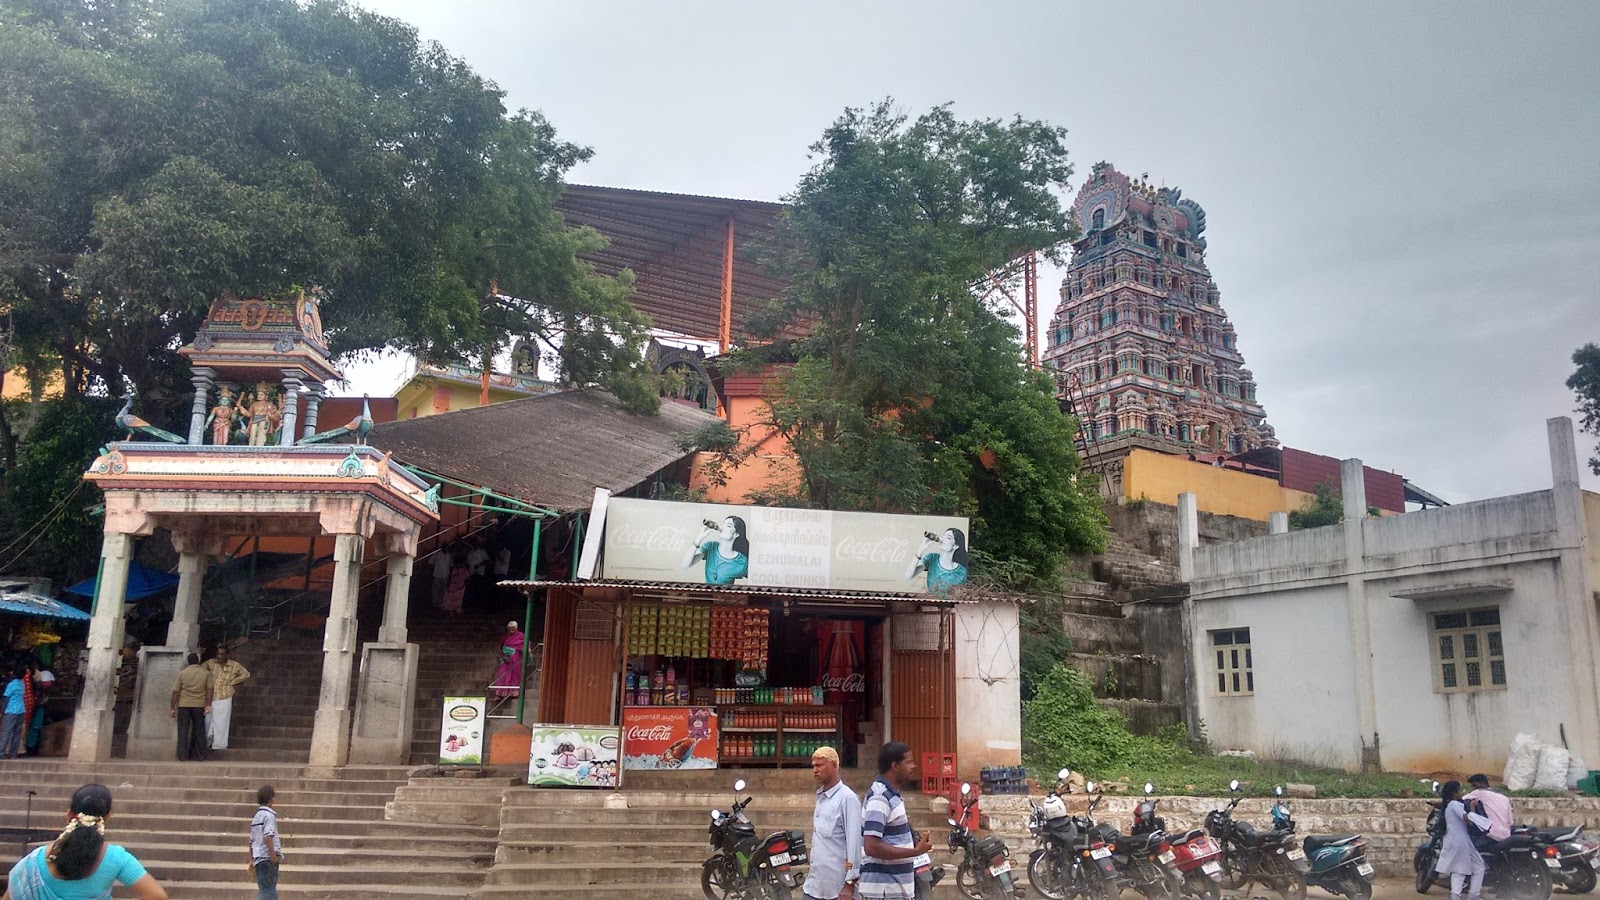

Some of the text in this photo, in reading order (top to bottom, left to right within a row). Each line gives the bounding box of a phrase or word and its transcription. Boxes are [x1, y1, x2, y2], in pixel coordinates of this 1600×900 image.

[758, 553, 822, 567] EZHUMALAI
[751, 573, 782, 585] COOL
[784, 574, 826, 587] DRINKS
[627, 725, 674, 741] Coca-Cola
